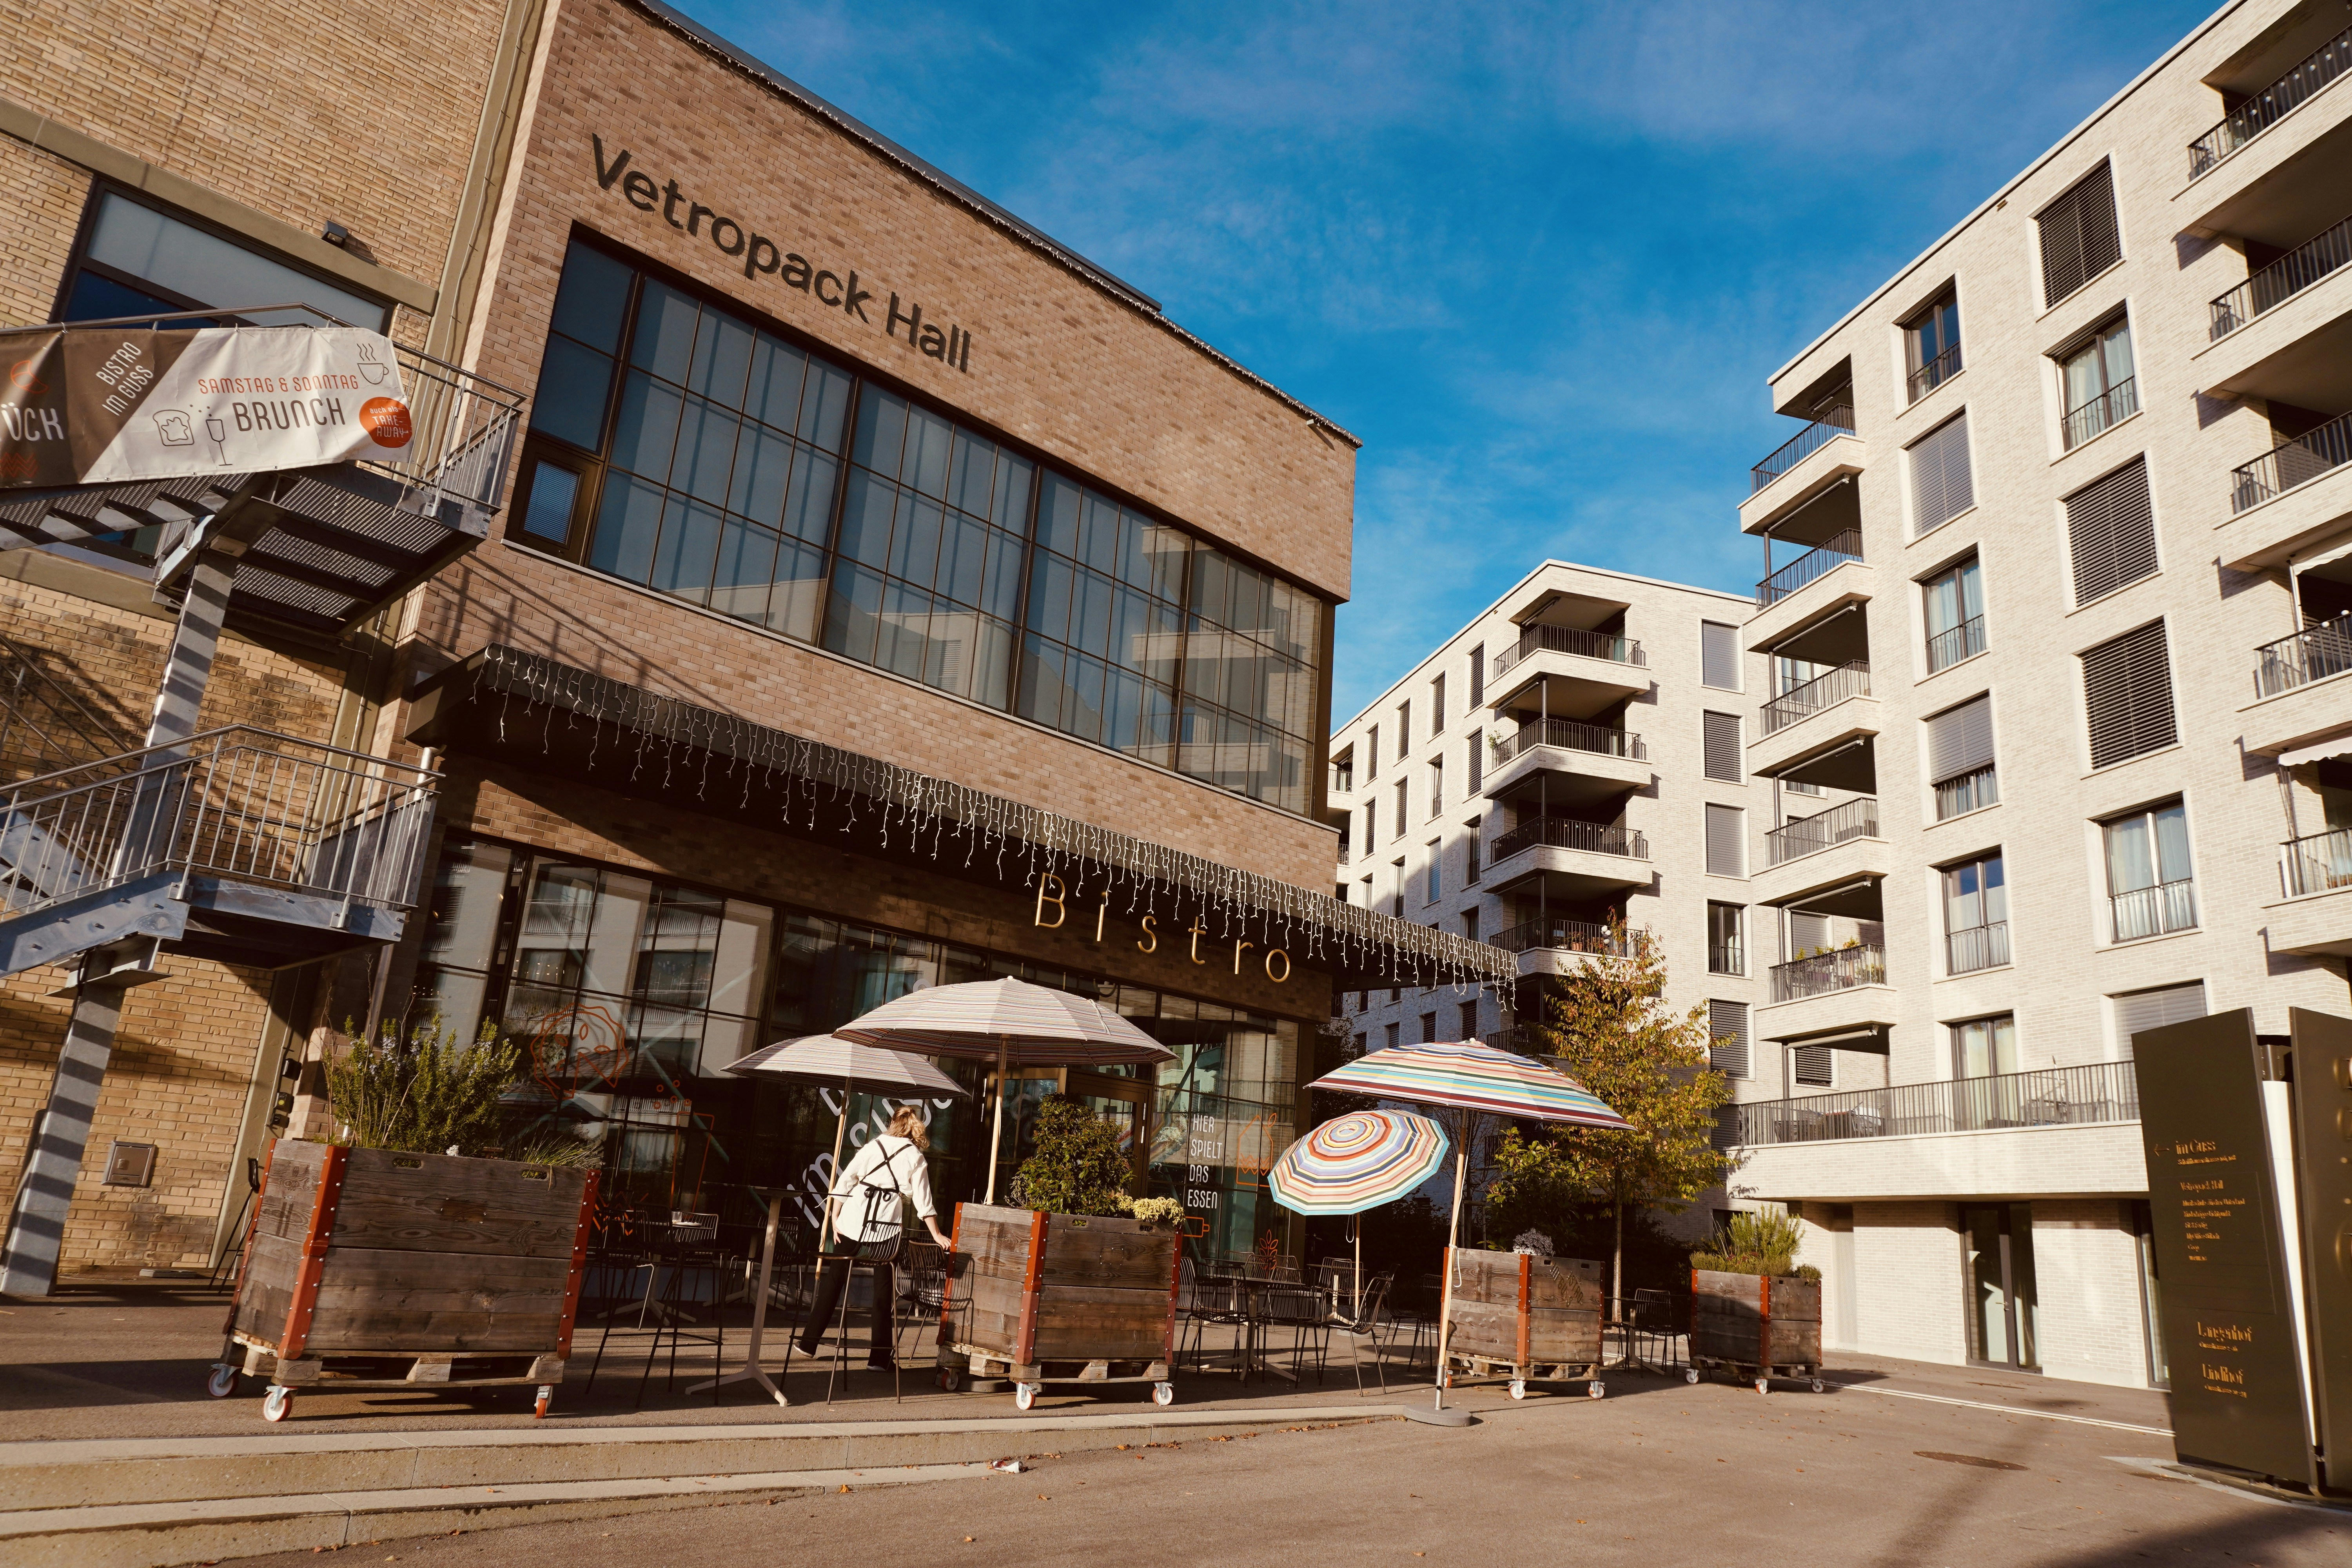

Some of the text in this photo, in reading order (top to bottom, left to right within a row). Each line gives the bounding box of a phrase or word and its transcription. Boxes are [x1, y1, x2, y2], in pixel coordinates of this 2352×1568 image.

[592, 132, 971, 374] Vetropack Hall
[96, 341, 142, 386] BISTRO
[102, 365, 154, 416] IM GUSS
[198, 375, 359, 394] SAMSTAG & SONNTAG
[232, 397, 345, 432] BRUNCH
[372, 415, 403, 426] TAKE-
[377, 426, 405, 438] AWAY
[1034, 872, 1290, 983] Bistro
[1192, 1114, 1215, 1134] HIER
[1190, 1140, 1223, 1159] SPIELT
[2190, 1139, 2216, 1154] Guss
[1189, 1164, 1209, 1183] DAS
[1187, 1189, 1218, 1209] ESSEN
